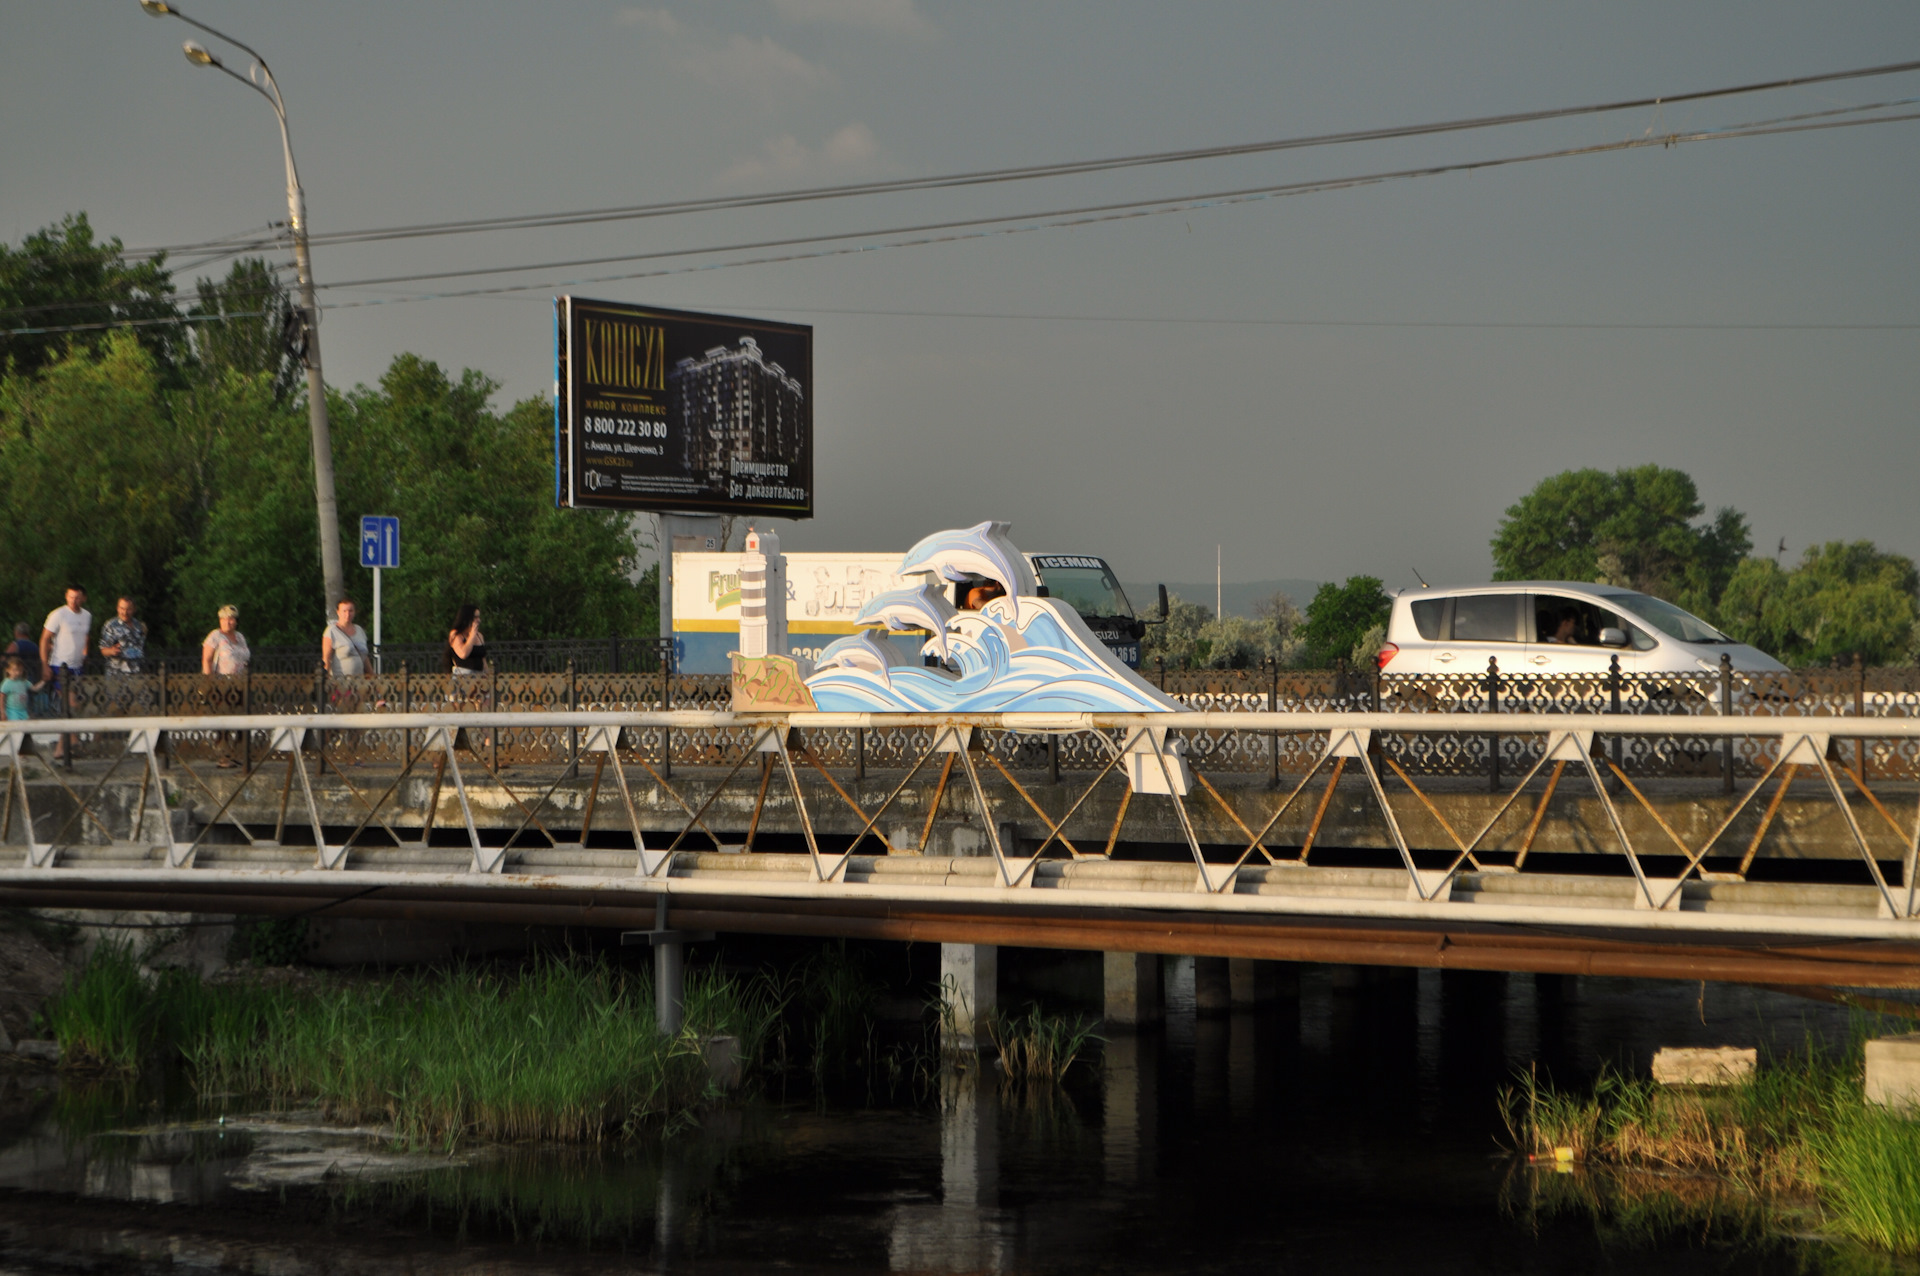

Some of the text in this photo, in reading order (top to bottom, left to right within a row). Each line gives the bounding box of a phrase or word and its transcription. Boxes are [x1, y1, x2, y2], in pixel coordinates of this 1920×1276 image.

[585, 318, 666, 391] КОНСУЛ
[584, 415, 667, 439] 8 800 222 30 80
[659, 445, 664, 456] 3
[730, 457, 789, 478] Преимущества
[729, 479, 744, 499] Без
[706, 539, 715, 548] 25
[1040, 557, 1102, 569] ICEMAN
[1093, 630, 1120, 640] SUZU
